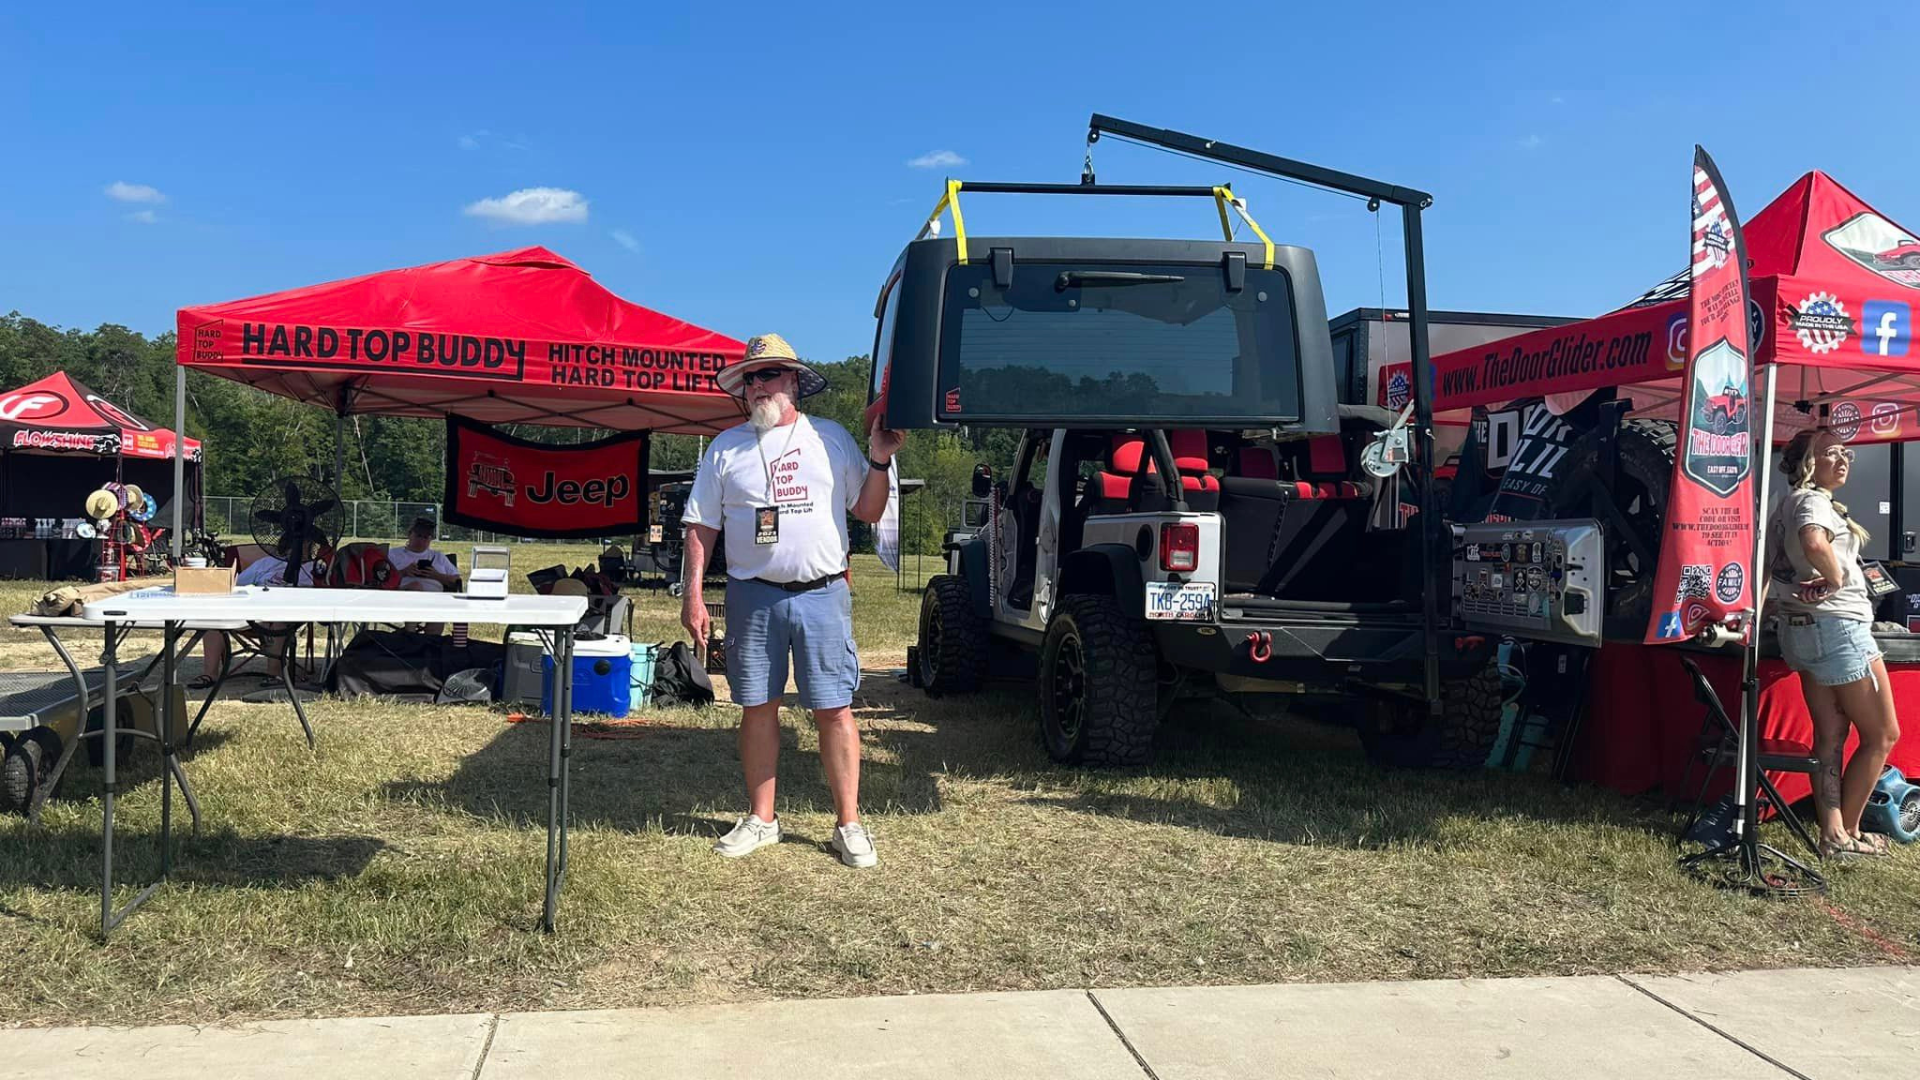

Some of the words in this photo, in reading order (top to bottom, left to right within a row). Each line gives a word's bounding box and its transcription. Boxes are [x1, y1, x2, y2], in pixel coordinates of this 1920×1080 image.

[1800, 315, 1843, 324] PROUDLY
[198, 329, 222, 338] HARD
[199, 340, 214, 348] TOP
[197, 350, 223, 361] BUDDY
[243, 323, 338, 358] HARD
[347, 328, 410, 362] TOP
[417, 332, 525, 378] BUDDY
[549, 344, 616, 365] HITCH
[623, 348, 726, 371] MOUNTED
[1443, 331, 1653, 397] www.TheDoorGlider.com
[552, 365, 615, 386] HARD
[623, 370, 665, 390] TOP
[672, 373, 717, 392] LIFT
[14, 429, 94, 450] FLOWSHINE
[1691, 428, 1710, 455] THE
[776, 475, 793, 485] TOP
[1503, 478, 1530, 492] EASY
[526, 471, 630, 508] Jeep
[777, 486, 807, 498] BUDDY
[1702, 507, 1719, 515] SCAN
[1700, 515, 1715, 523] CODE
[1718, 578, 1742, 588] FAMILY
